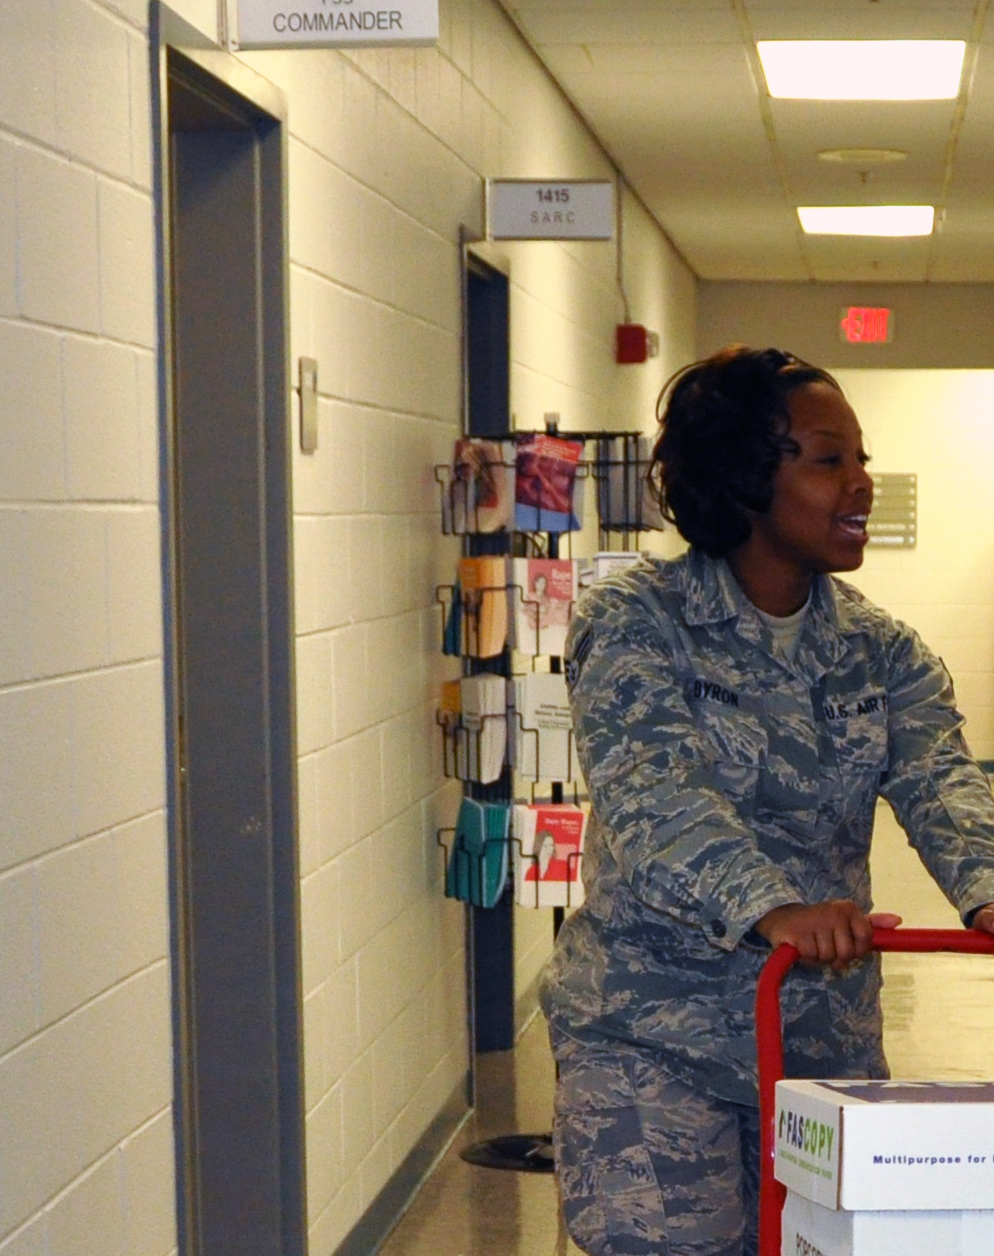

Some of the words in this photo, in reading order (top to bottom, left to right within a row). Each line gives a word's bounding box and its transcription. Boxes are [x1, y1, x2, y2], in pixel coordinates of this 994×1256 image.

[272, 11, 403, 32] COMMANDER
[536, 188, 570, 203] 1415
[694, 680, 739, 707] BYRON
[824, 702, 853, 720] U.S.
[857, 697, 880, 715] AIR
[786, 1111, 835, 1161] FASCOPY
[873, 1155, 961, 1167] Multipurpose
[967, 1154, 986, 1164] for
